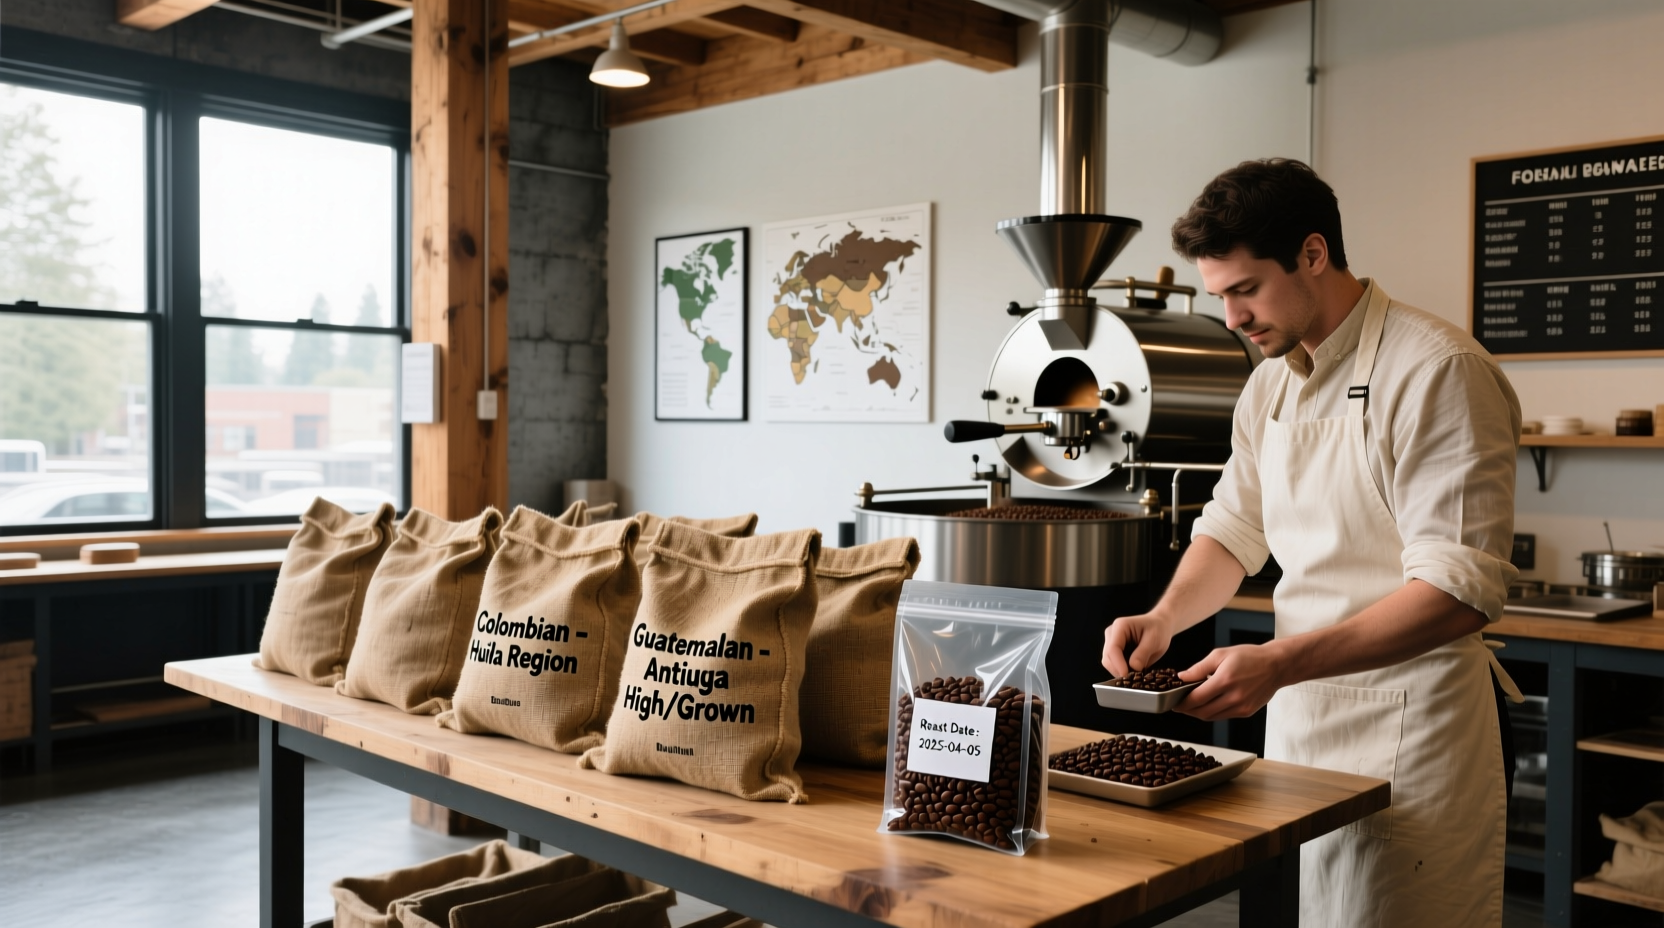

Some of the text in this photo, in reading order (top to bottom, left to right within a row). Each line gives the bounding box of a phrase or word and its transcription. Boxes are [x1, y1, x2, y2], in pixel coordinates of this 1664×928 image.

[477, 610, 570, 642] Colombian
[633, 622, 754, 660] Guatemalan
[470, 639, 578, 677] Huila Region
[643, 657, 729, 696] Antiuga
[623, 684, 755, 724] High/Grown
[920, 718, 980, 737] Roast Date:
[919, 738, 981, 757] 2025-04-05
